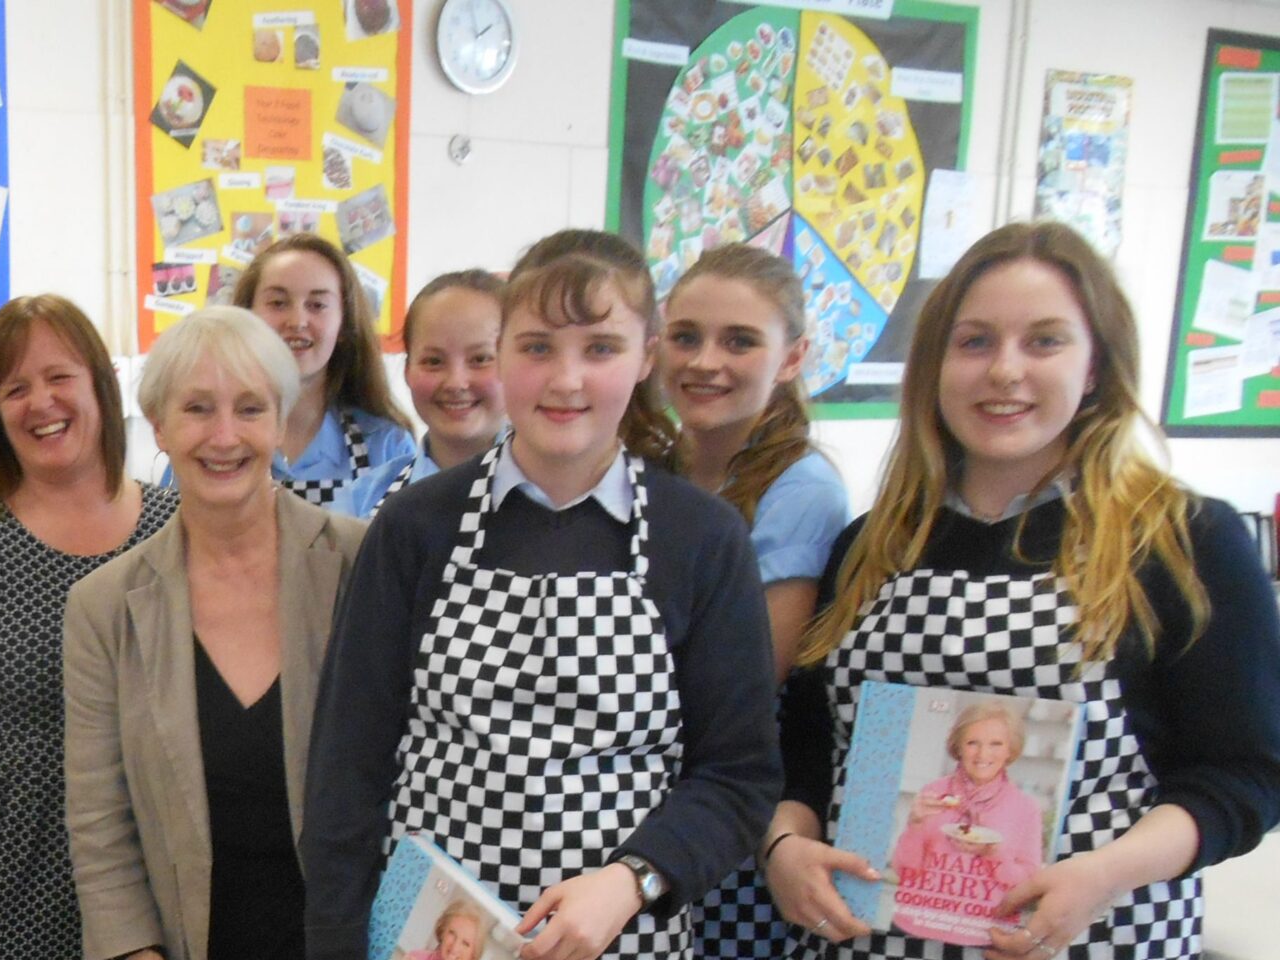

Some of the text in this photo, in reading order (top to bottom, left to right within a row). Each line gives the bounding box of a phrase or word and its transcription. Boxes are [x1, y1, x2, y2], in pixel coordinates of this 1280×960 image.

[927, 851, 1003, 880] MARY
[898, 866, 1017, 901] BERRY'
[894, 890, 961, 913] COOKERY
